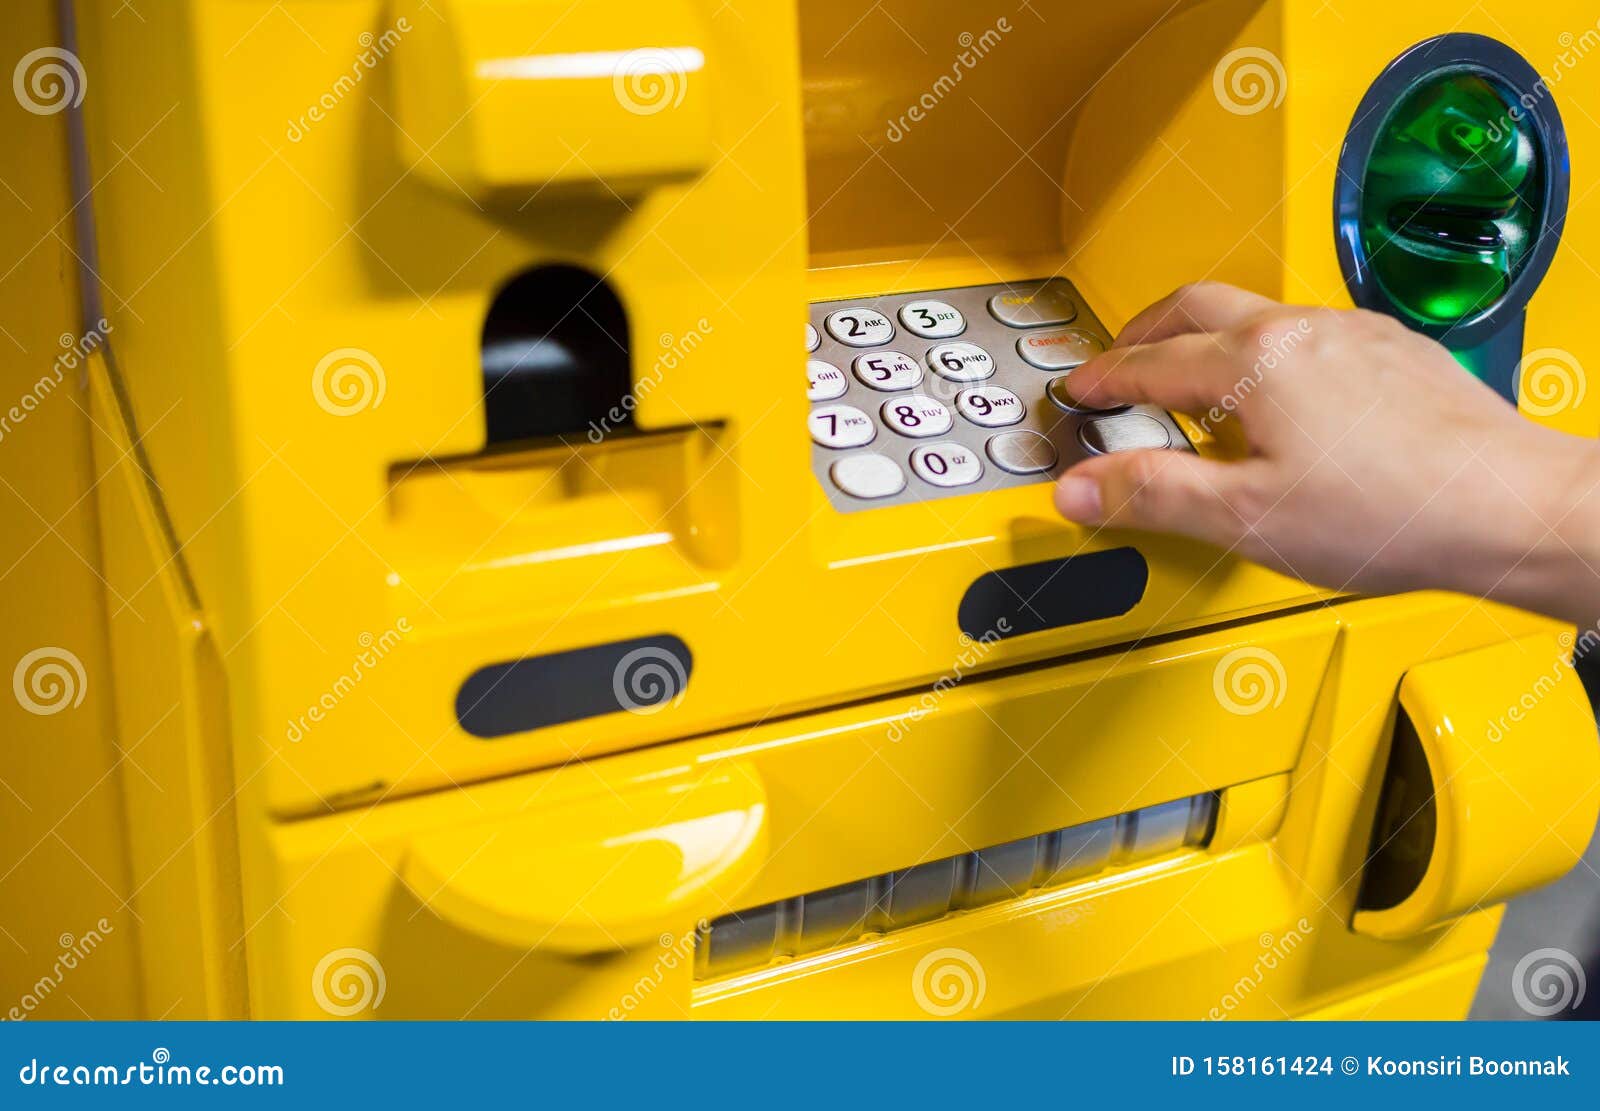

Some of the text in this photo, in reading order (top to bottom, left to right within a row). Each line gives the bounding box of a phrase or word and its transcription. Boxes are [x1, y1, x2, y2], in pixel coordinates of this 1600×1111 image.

[839, 316, 885, 337] 2 ABC
[912, 309, 957, 328] 3 DEF
[867, 359, 912, 381] 5 JKL
[940, 351, 987, 371] 6 MNO
[817, 371, 838, 380] GHI
[968, 395, 1015, 416] 9 WXY
[816, 414, 867, 437] 7 PRS
[895, 406, 943, 427] 8 TUV
[923, 453, 969, 475] 0 QZ
